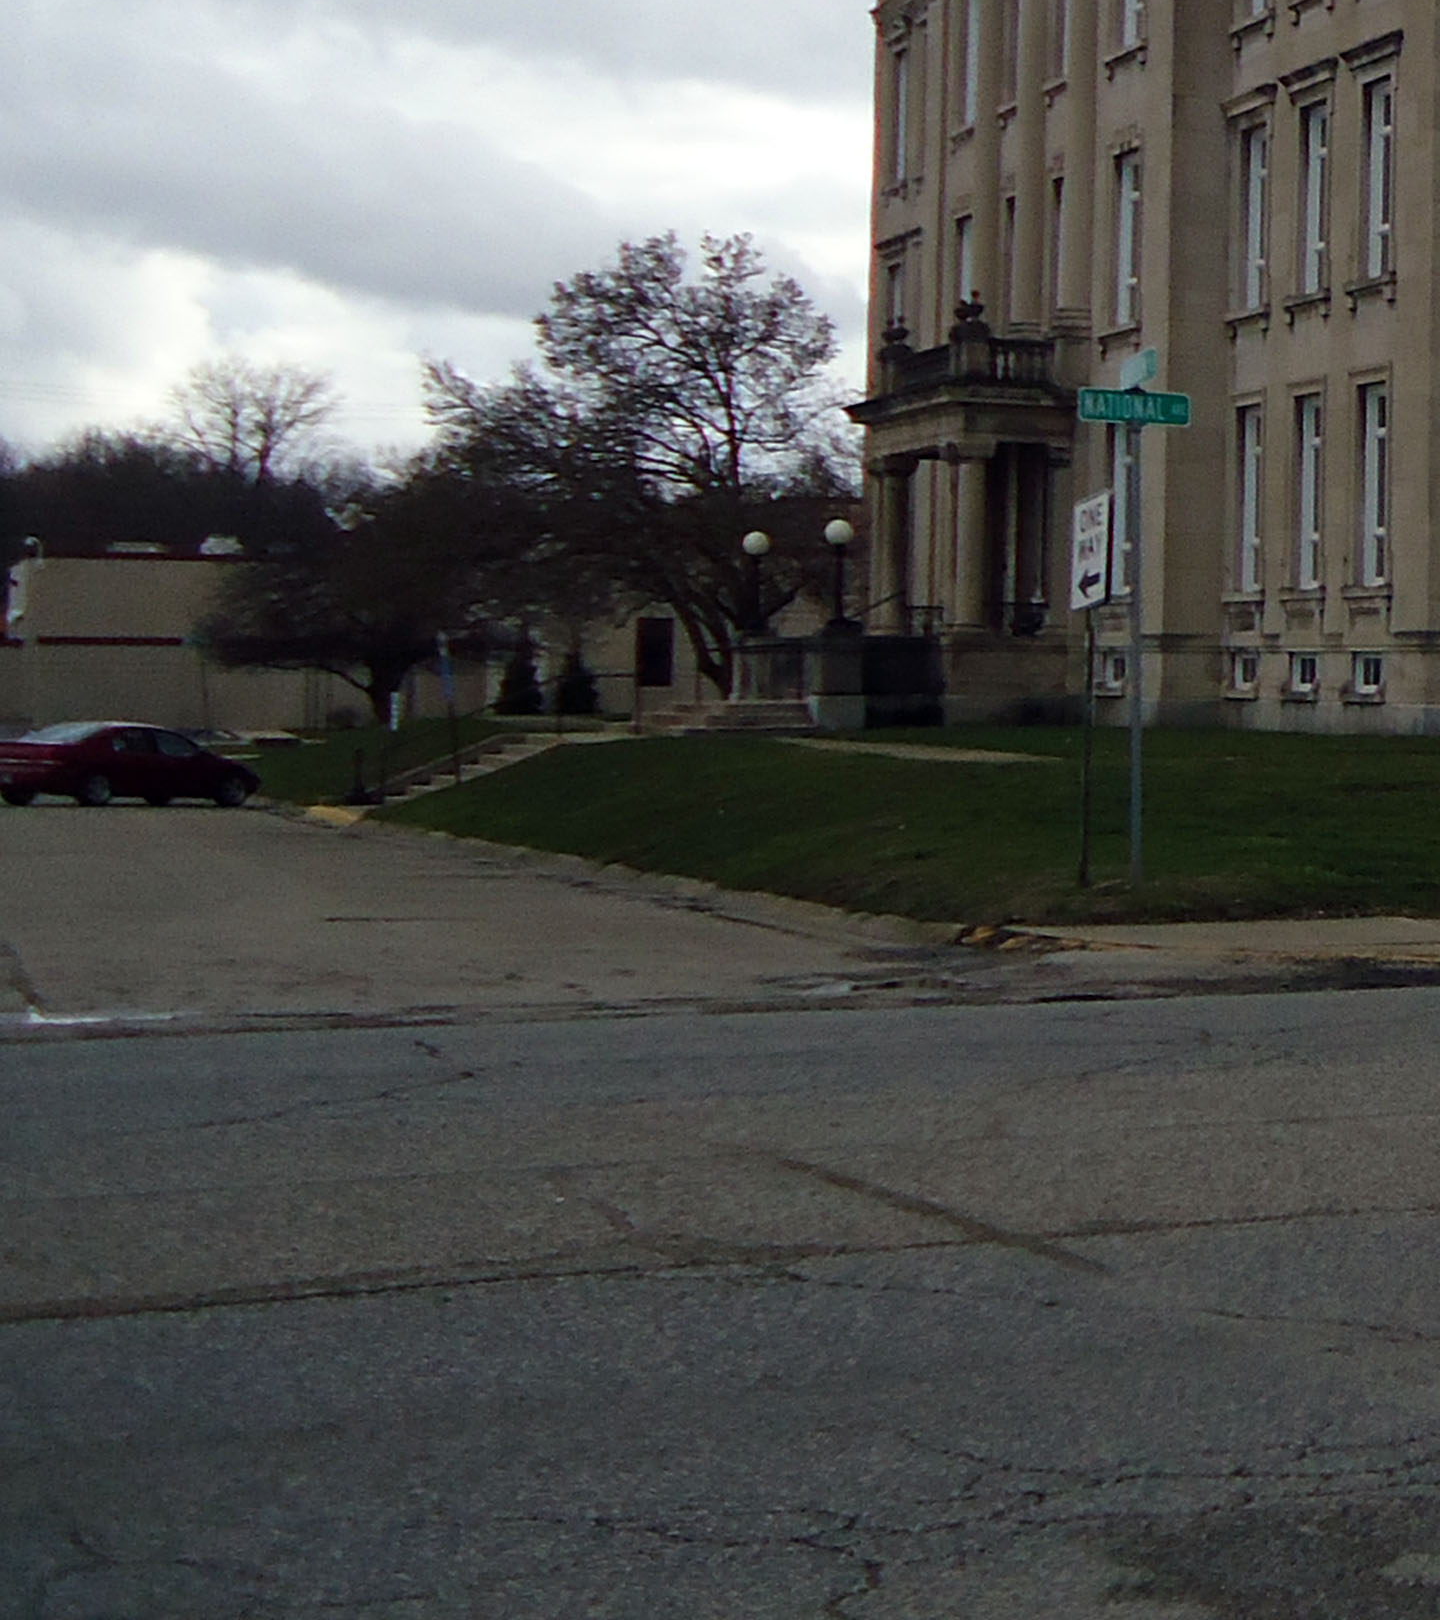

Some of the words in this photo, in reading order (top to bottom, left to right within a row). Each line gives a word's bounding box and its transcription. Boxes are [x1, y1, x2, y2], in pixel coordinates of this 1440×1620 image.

[1084, 392, 1165, 421] NATIONAL
[1079, 501, 1103, 534] ONE
[1078, 533, 1103, 562] WAY
